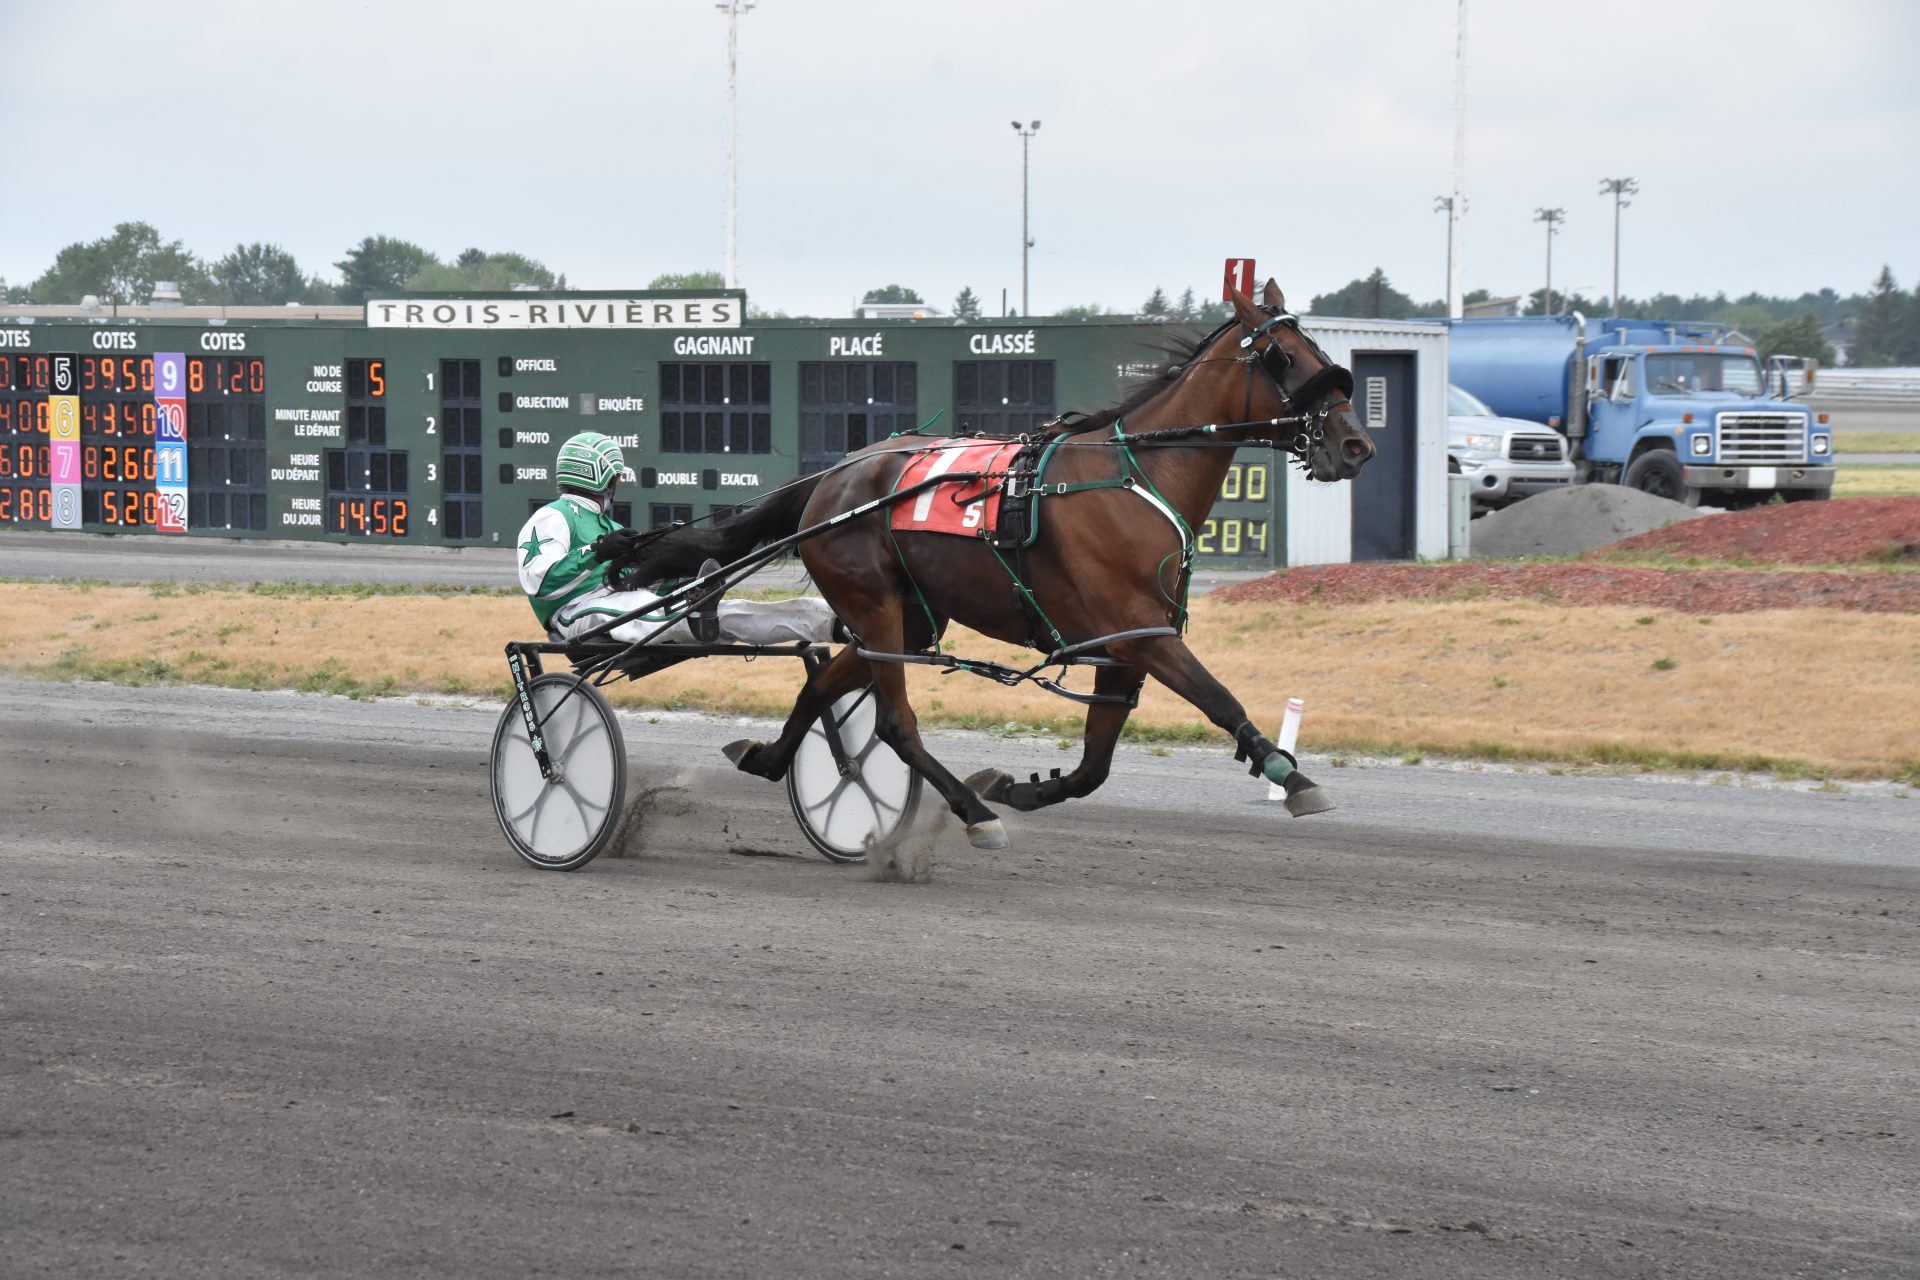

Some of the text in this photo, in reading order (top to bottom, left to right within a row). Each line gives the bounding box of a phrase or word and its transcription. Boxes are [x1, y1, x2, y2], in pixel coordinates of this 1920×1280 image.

[1232, 260, 1244, 293] 1
[377, 300, 731, 324] TROIS-RIVIÈRES
[92, 331, 137, 349] COTES
[200, 332, 245, 350] COTES
[674, 336, 754, 355] GAGNANT
[830, 332, 883, 356] PLACÉ
[969, 330, 1035, 354] CLASSÉ
[313, 366, 342, 377] NO DE
[516, 359, 557, 371] OFFICIEL
[54, 357, 72, 391] 5
[162, 360, 177, 391] 9
[370, 362, 385, 396] 5
[426, 373, 434, 390] 1
[306, 381, 342, 393] COURSE
[516, 397, 569, 408] OBJECTION
[598, 397, 643, 411] ENQUÊTE
[56, 400, 73, 436] 6
[157, 404, 184, 438] 10
[275, 409, 341, 421] MINUTE AVANT
[294, 423, 341, 437] LE DÉPART
[426, 417, 436, 434] 2
[516, 432, 550, 444] PHOTO
[57, 445, 73, 479] 7
[159, 447, 183, 482] 11
[290, 454, 320, 466] HEURE
[271, 467, 320, 481] DU DÉPART
[427, 464, 437, 481] 3
[516, 468, 548, 480] SUPER
[658, 472, 698, 485] DOUBLE
[720, 473, 759, 486] EXACTA
[57, 488, 75, 525] 8
[157, 493, 185, 527] 12
[291, 498, 321, 510] HEURE
[283, 513, 321, 525] DU JOUR
[340, 501, 407, 535] 14:52
[427, 509, 437, 526] 4
[961, 500, 984, 528] 5
